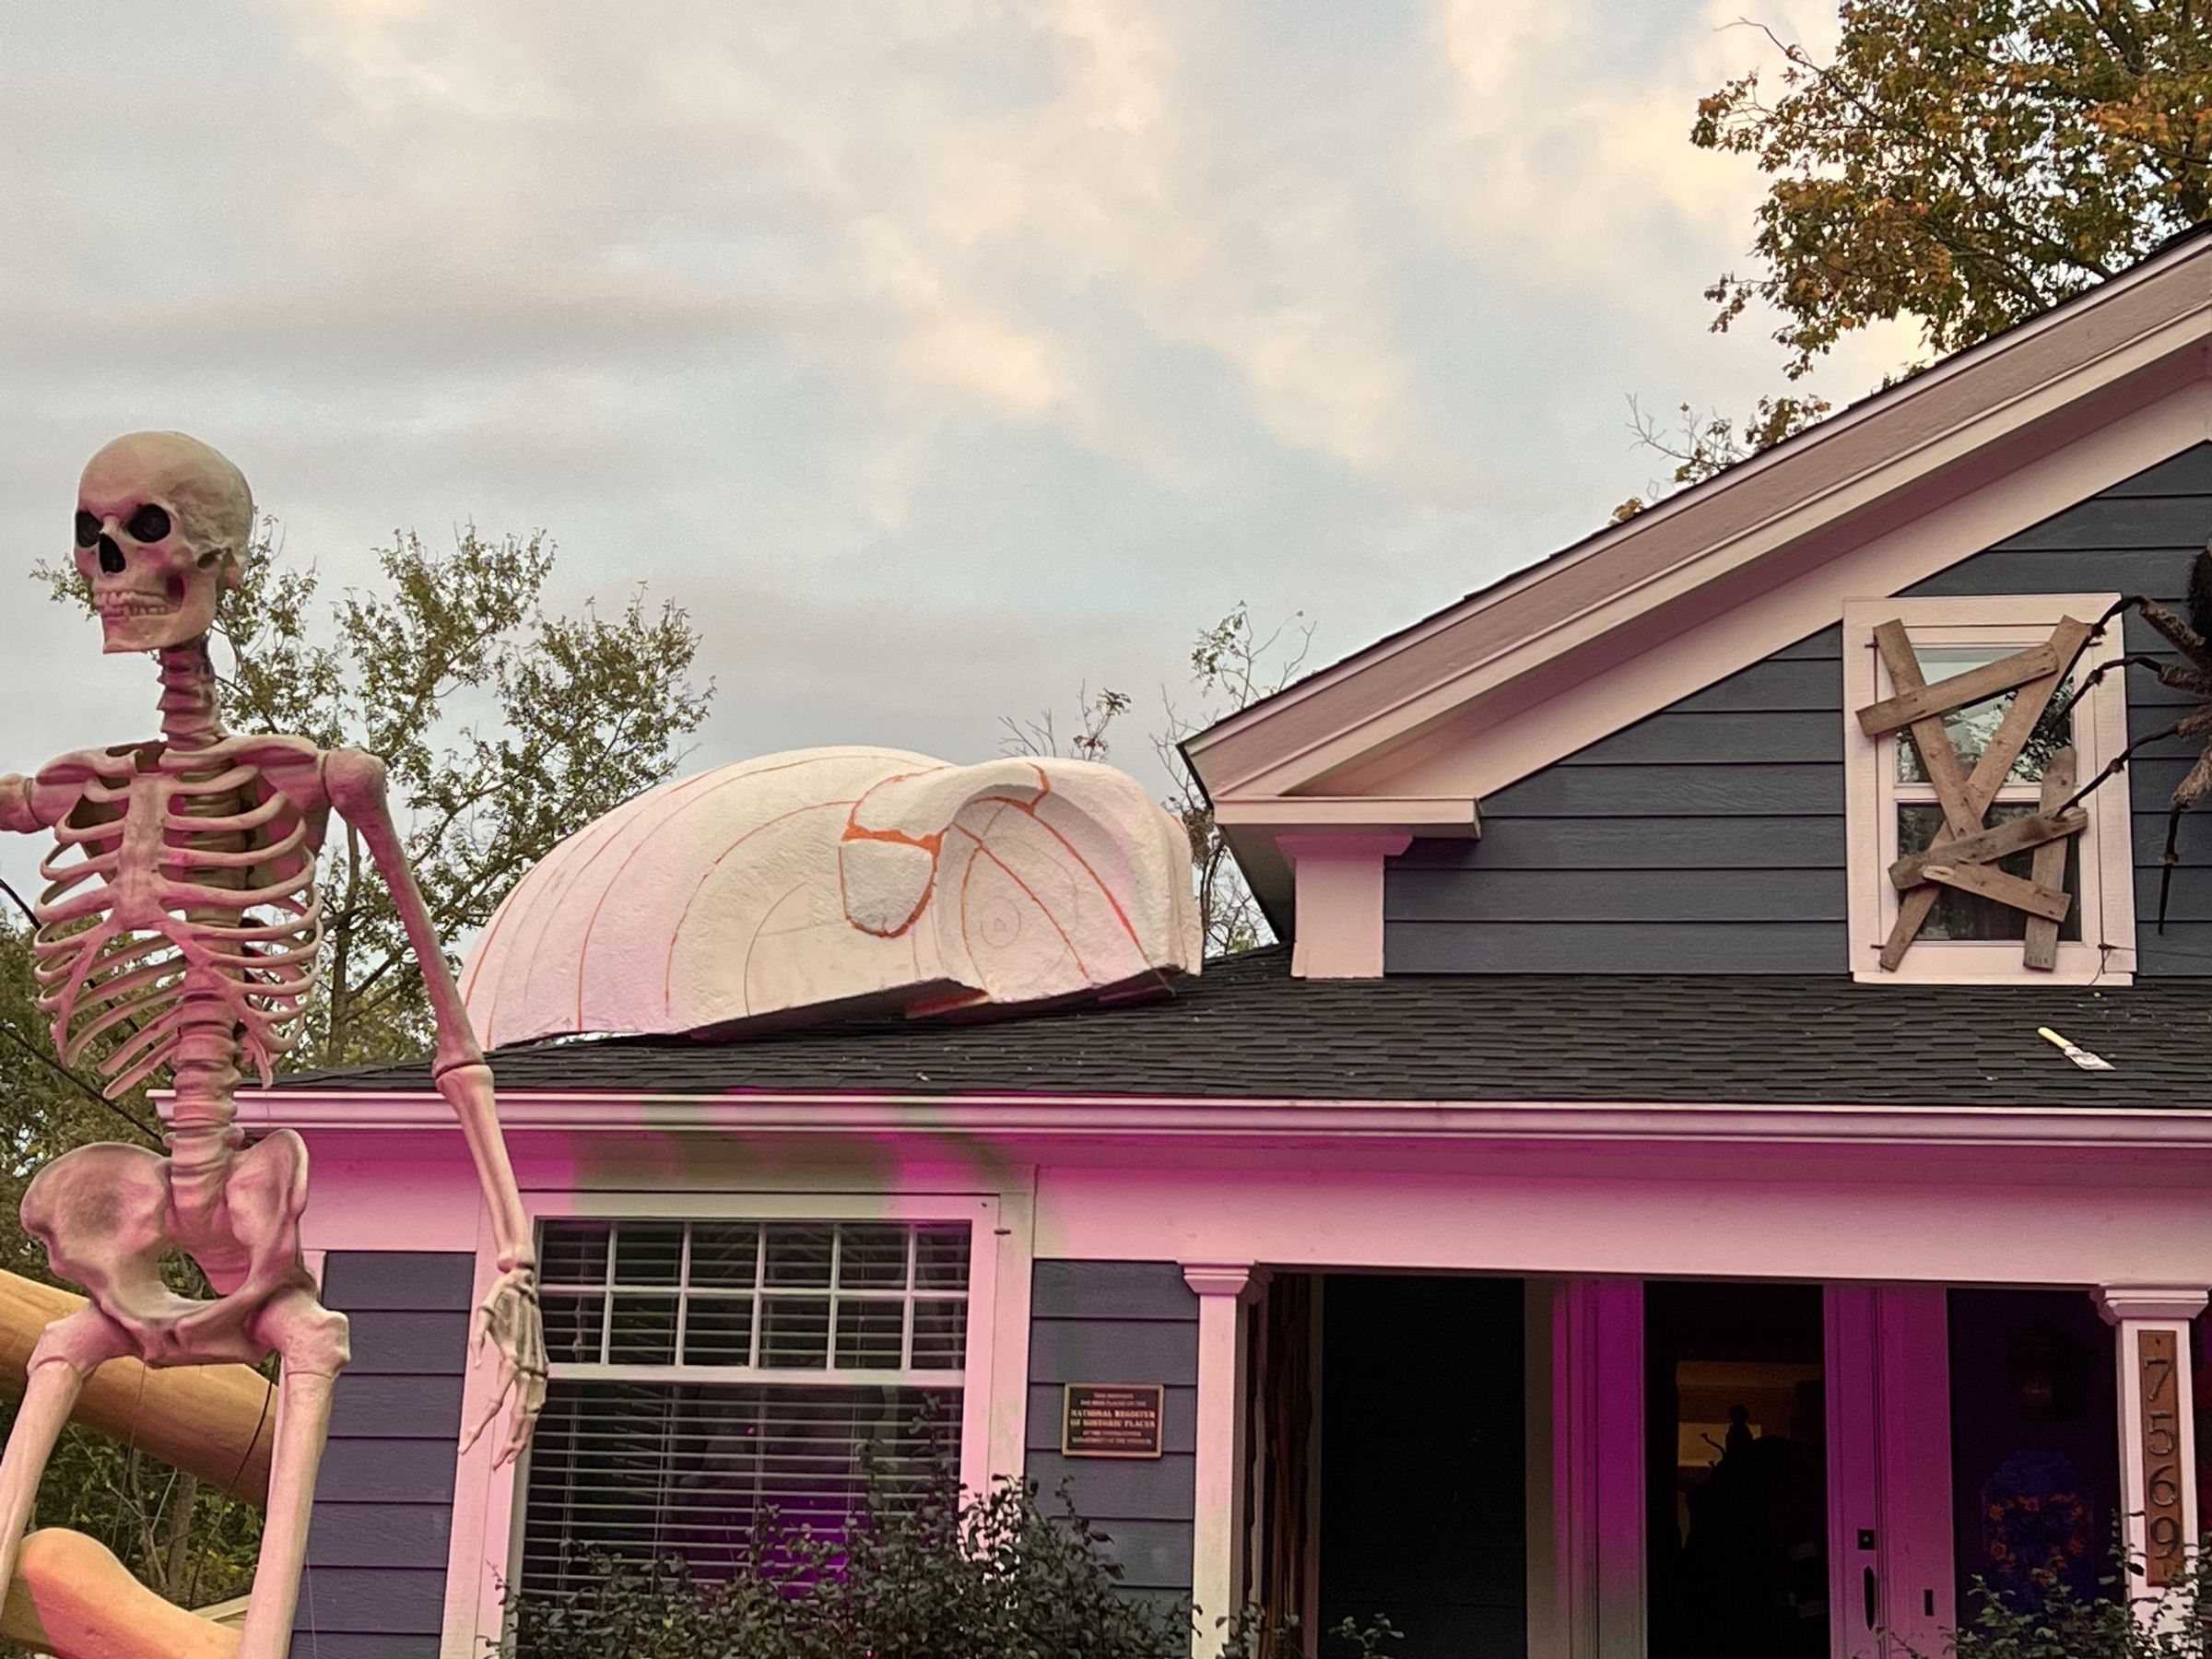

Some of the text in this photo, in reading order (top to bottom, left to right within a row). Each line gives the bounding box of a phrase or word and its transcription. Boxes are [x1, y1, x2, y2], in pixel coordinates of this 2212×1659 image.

[1070, 1409, 1156, 1418] NATIONAL REGISTER
[1124, 1419, 1156, 1428] PLACES
[2143, 1357, 2180, 1559] 7569
